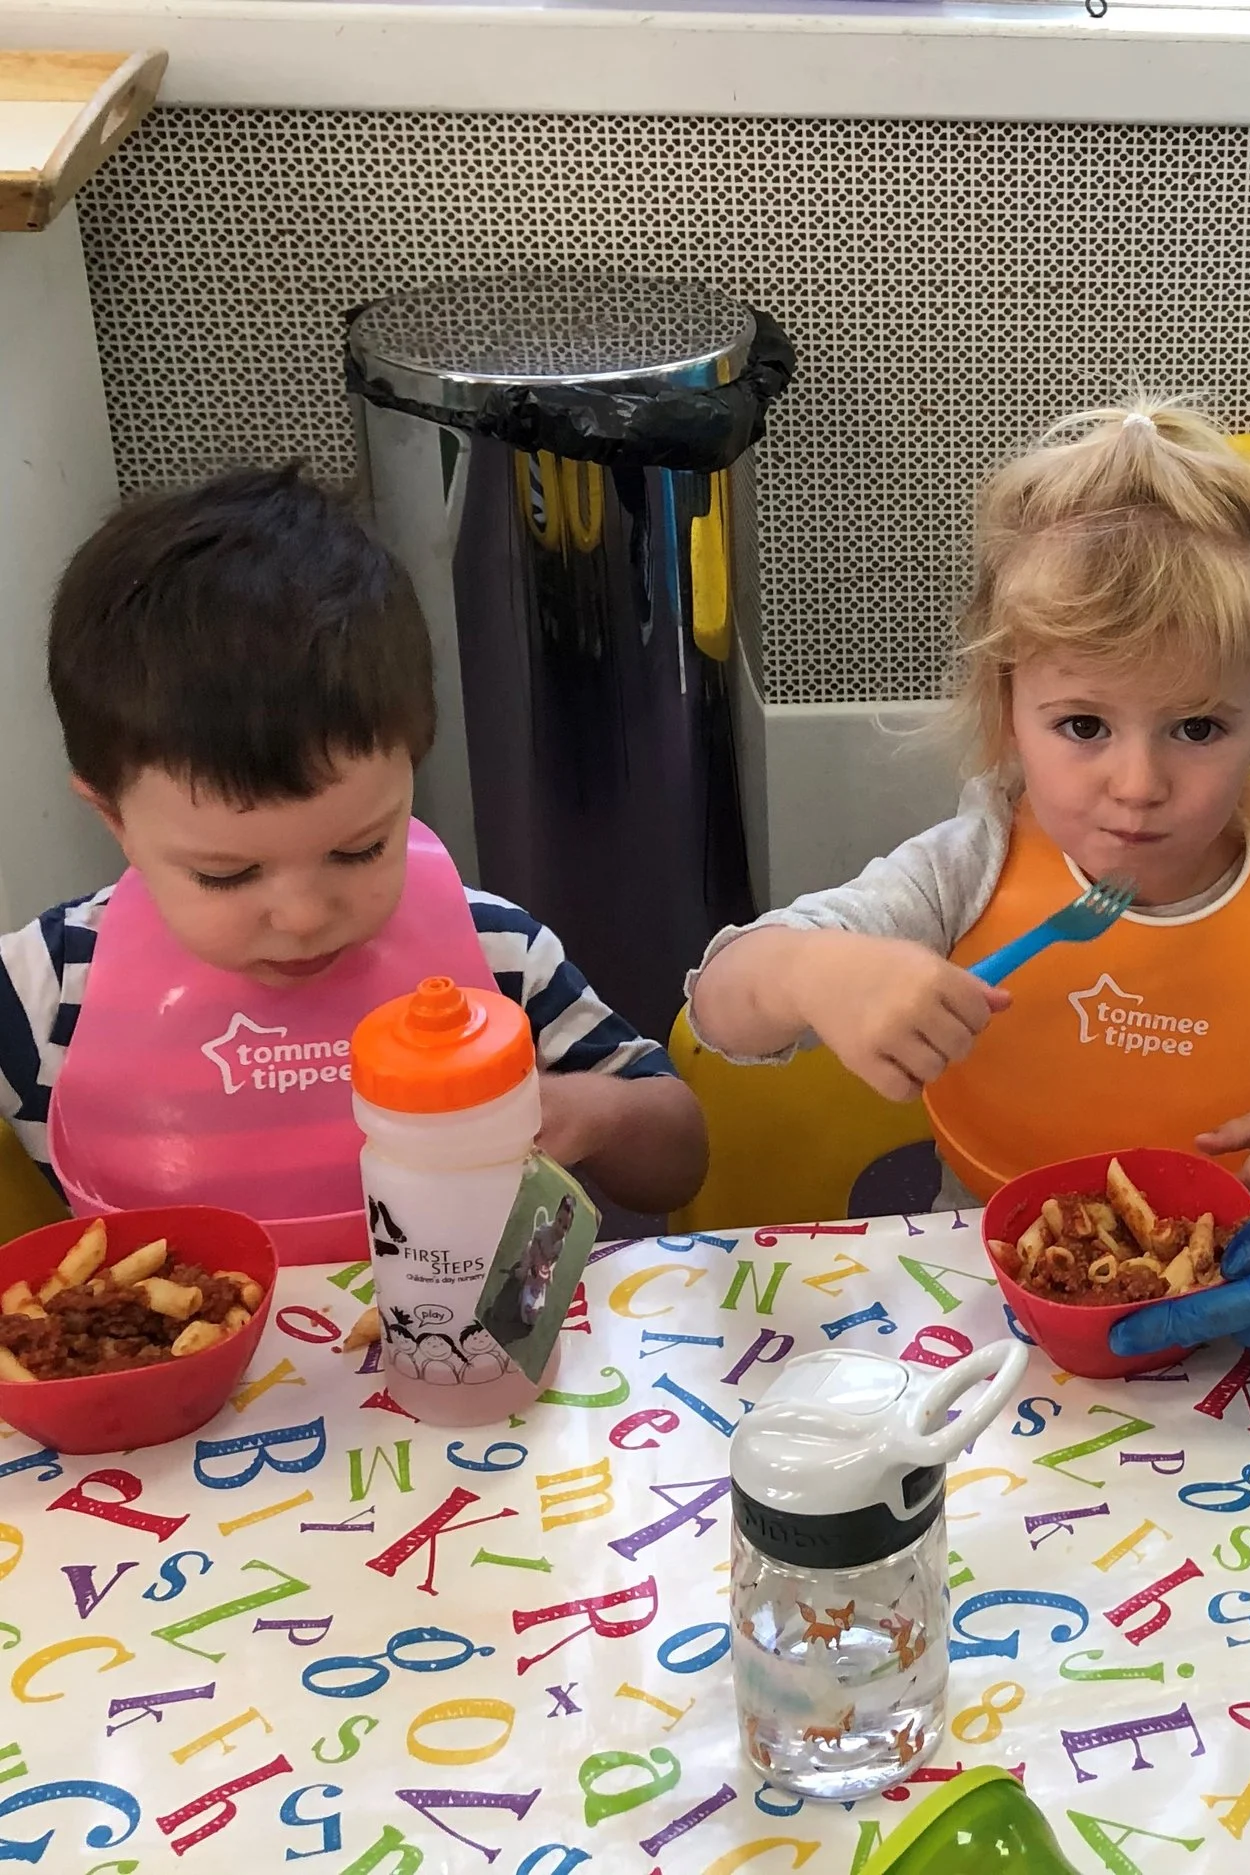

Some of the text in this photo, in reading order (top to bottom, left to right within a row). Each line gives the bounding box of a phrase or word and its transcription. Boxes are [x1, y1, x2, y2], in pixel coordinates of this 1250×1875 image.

[1097, 1002, 1210, 1036] tommee
[1105, 1026, 1193, 1056] tippee
[237, 1040, 351, 1065] tomme
[251, 1064, 352, 1093] tippee
[404, 1247, 450, 1262] FIRST
[431, 1257, 484, 1275] STEPS
[719, 1259, 792, 1315] N
[898, 1255, 998, 1315] A
[421, 1309, 440, 1321] play
[193, 1415, 327, 1490] B
[347, 1439, 415, 1503] M
[365, 1486, 520, 1597] K
[512, 1574, 659, 1677] R
[10, 1635, 136, 1704] C
[951, 1681, 1026, 1745] 8
[1060, 1702, 1207, 1784] E
